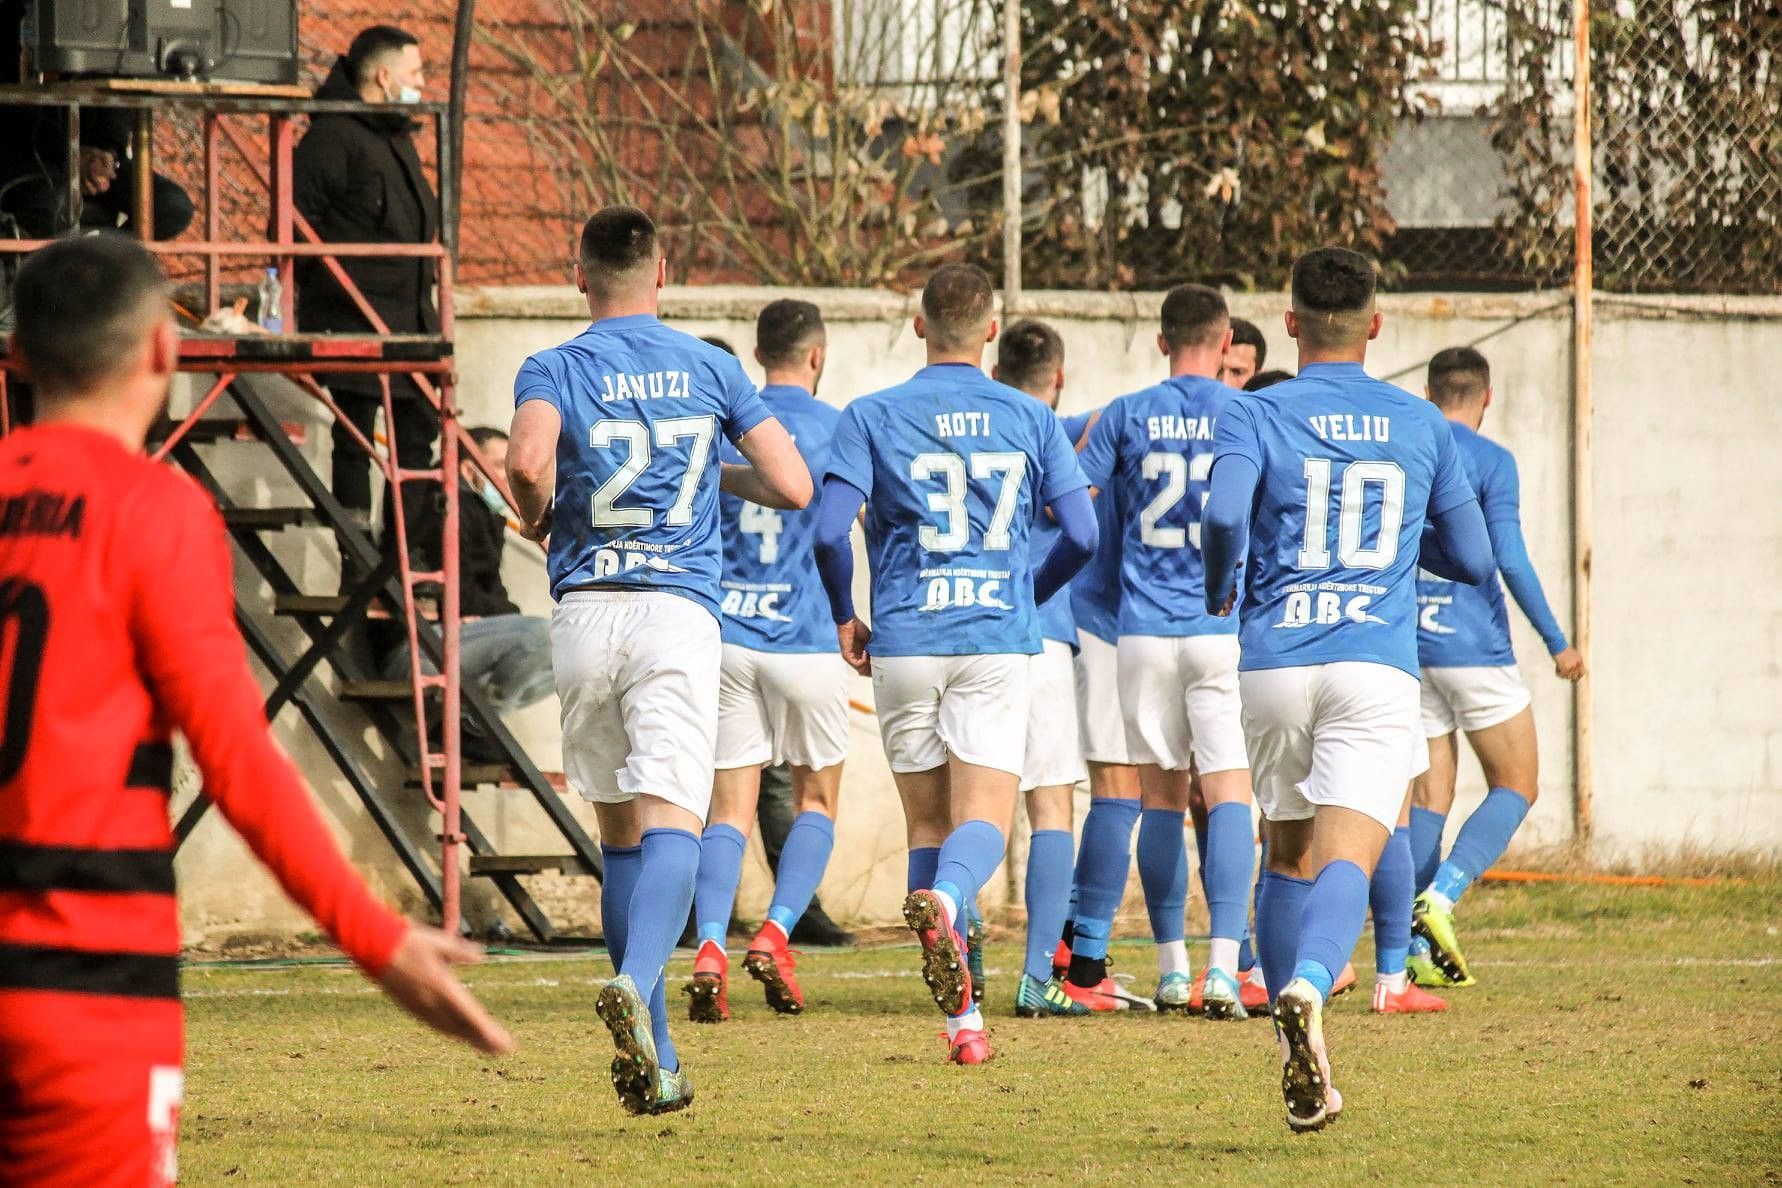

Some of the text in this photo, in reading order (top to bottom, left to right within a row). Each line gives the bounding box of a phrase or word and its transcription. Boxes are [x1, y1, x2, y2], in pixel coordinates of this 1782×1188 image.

[601, 370, 690, 402] JANUZI
[936, 412, 990, 437] HOTI
[1147, 415, 1216, 441] SHABA
[1309, 415, 1390, 442] VELIU
[589, 414, 715, 528] 27
[910, 452, 1027, 552] 37
[1298, 457, 1406, 571] 10
[739, 500, 783, 564] 4
[721, 590, 793, 623] ABC
[917, 577, 1014, 611] ABC
[1272, 591, 1390, 628] ABC
